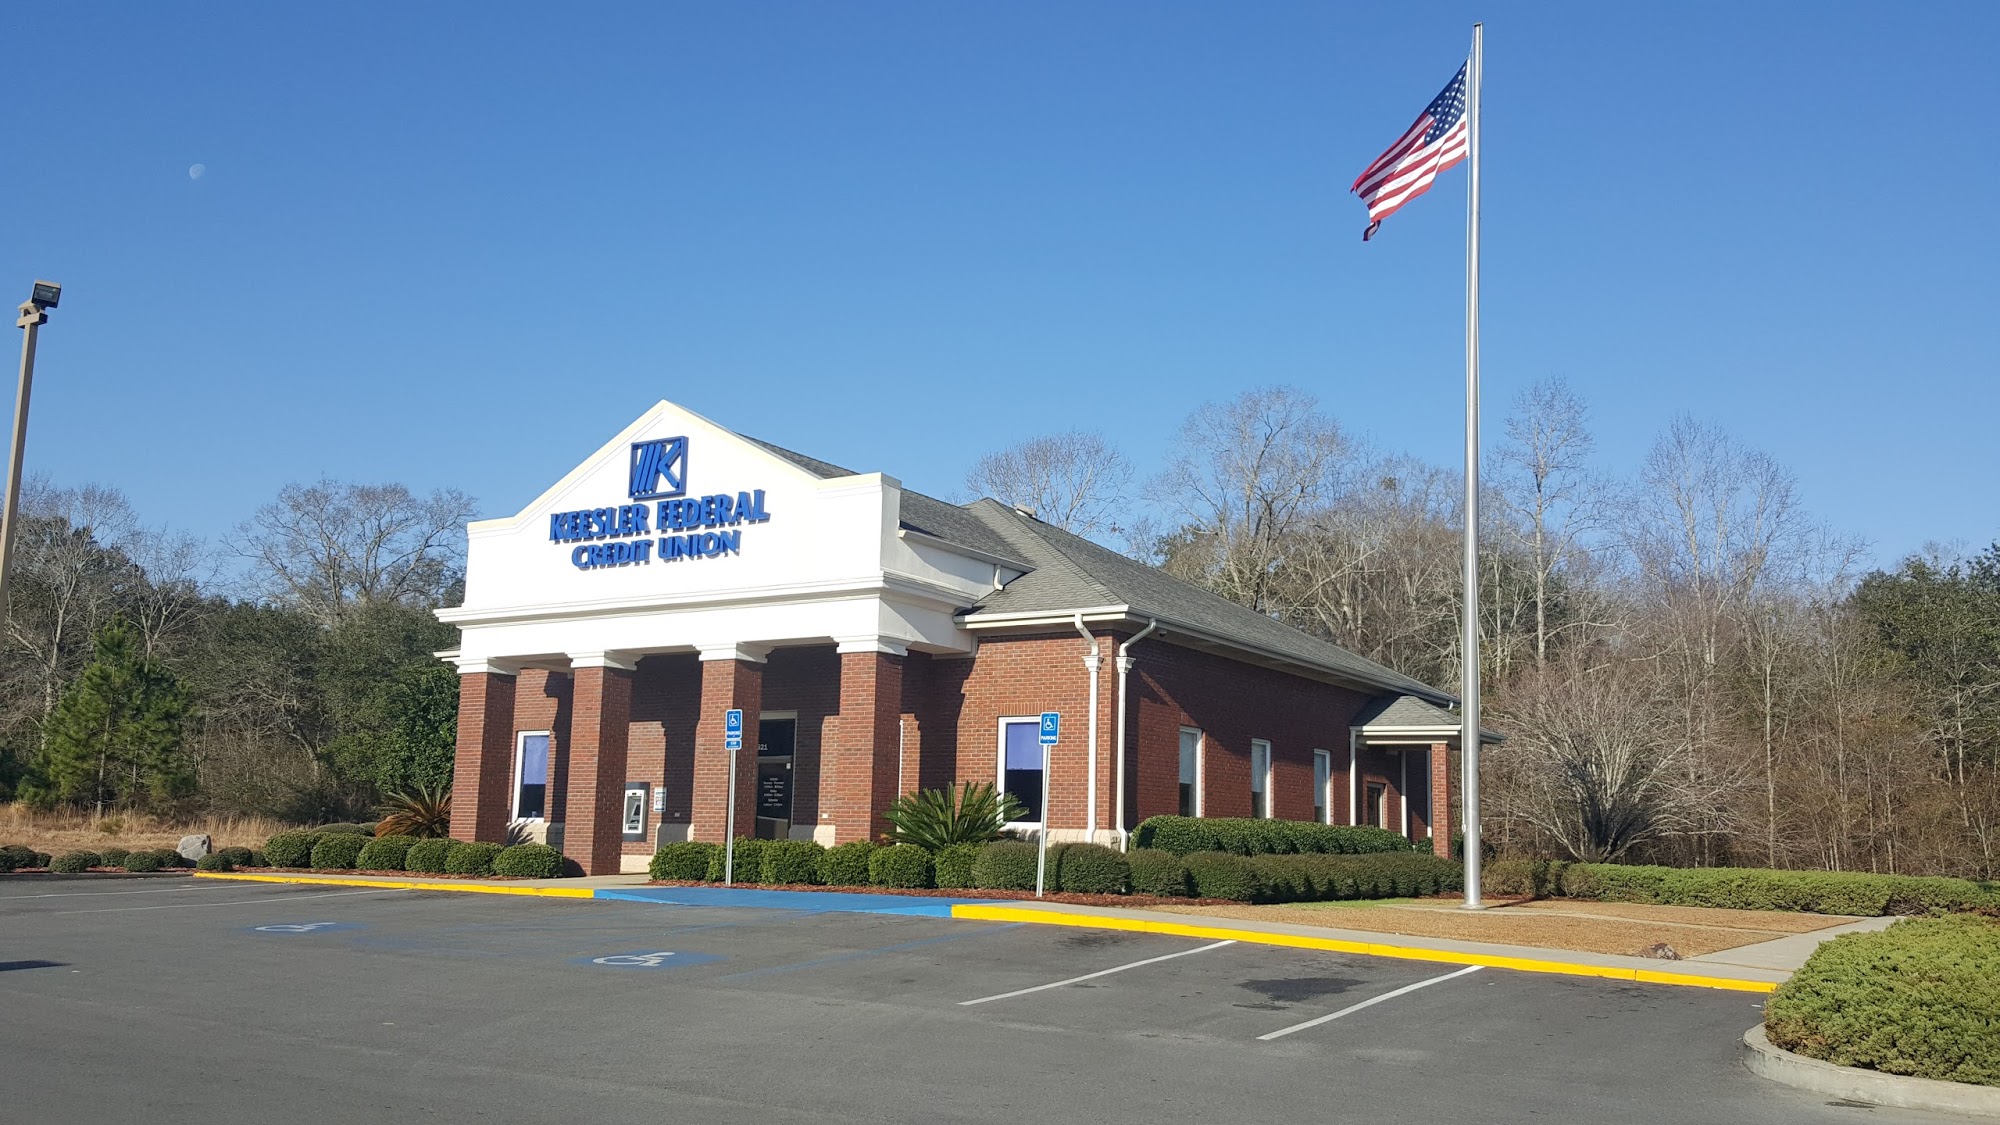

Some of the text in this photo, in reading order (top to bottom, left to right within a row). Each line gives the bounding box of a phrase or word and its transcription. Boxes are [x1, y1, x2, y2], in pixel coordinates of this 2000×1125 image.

[549, 489, 770, 543] KEESLER FEDERAL
[572, 530, 741, 569] CREDIT UNION
